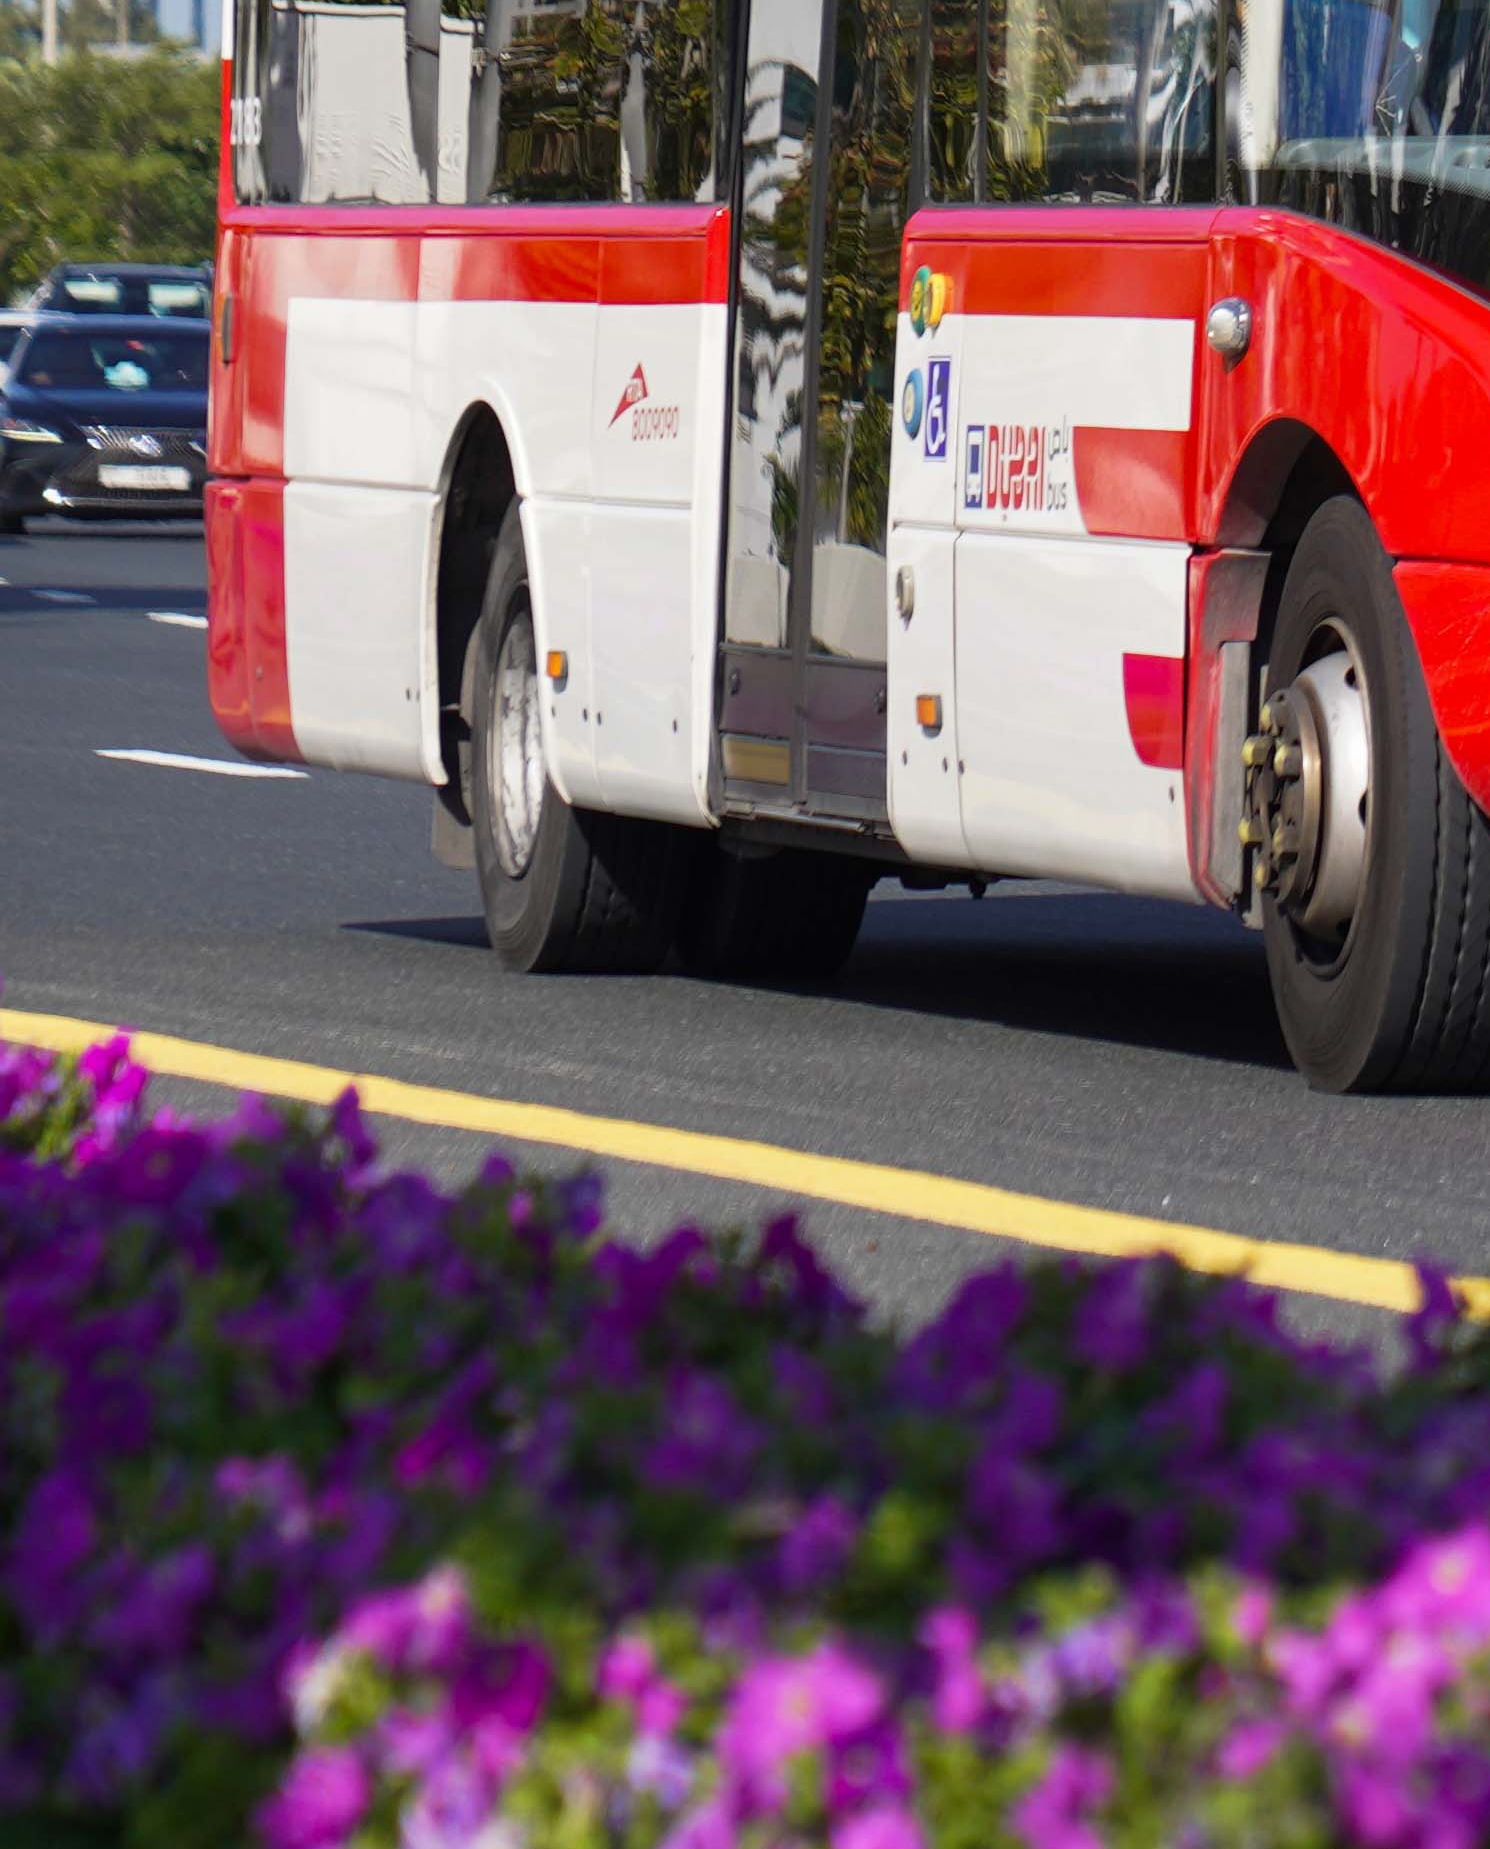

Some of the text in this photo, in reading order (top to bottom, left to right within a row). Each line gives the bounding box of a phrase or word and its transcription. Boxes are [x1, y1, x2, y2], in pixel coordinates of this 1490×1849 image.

[632, 406, 679, 441] 8009090
[987, 425, 1046, 519] DUBAI
[1046, 474, 1068, 511] bus
